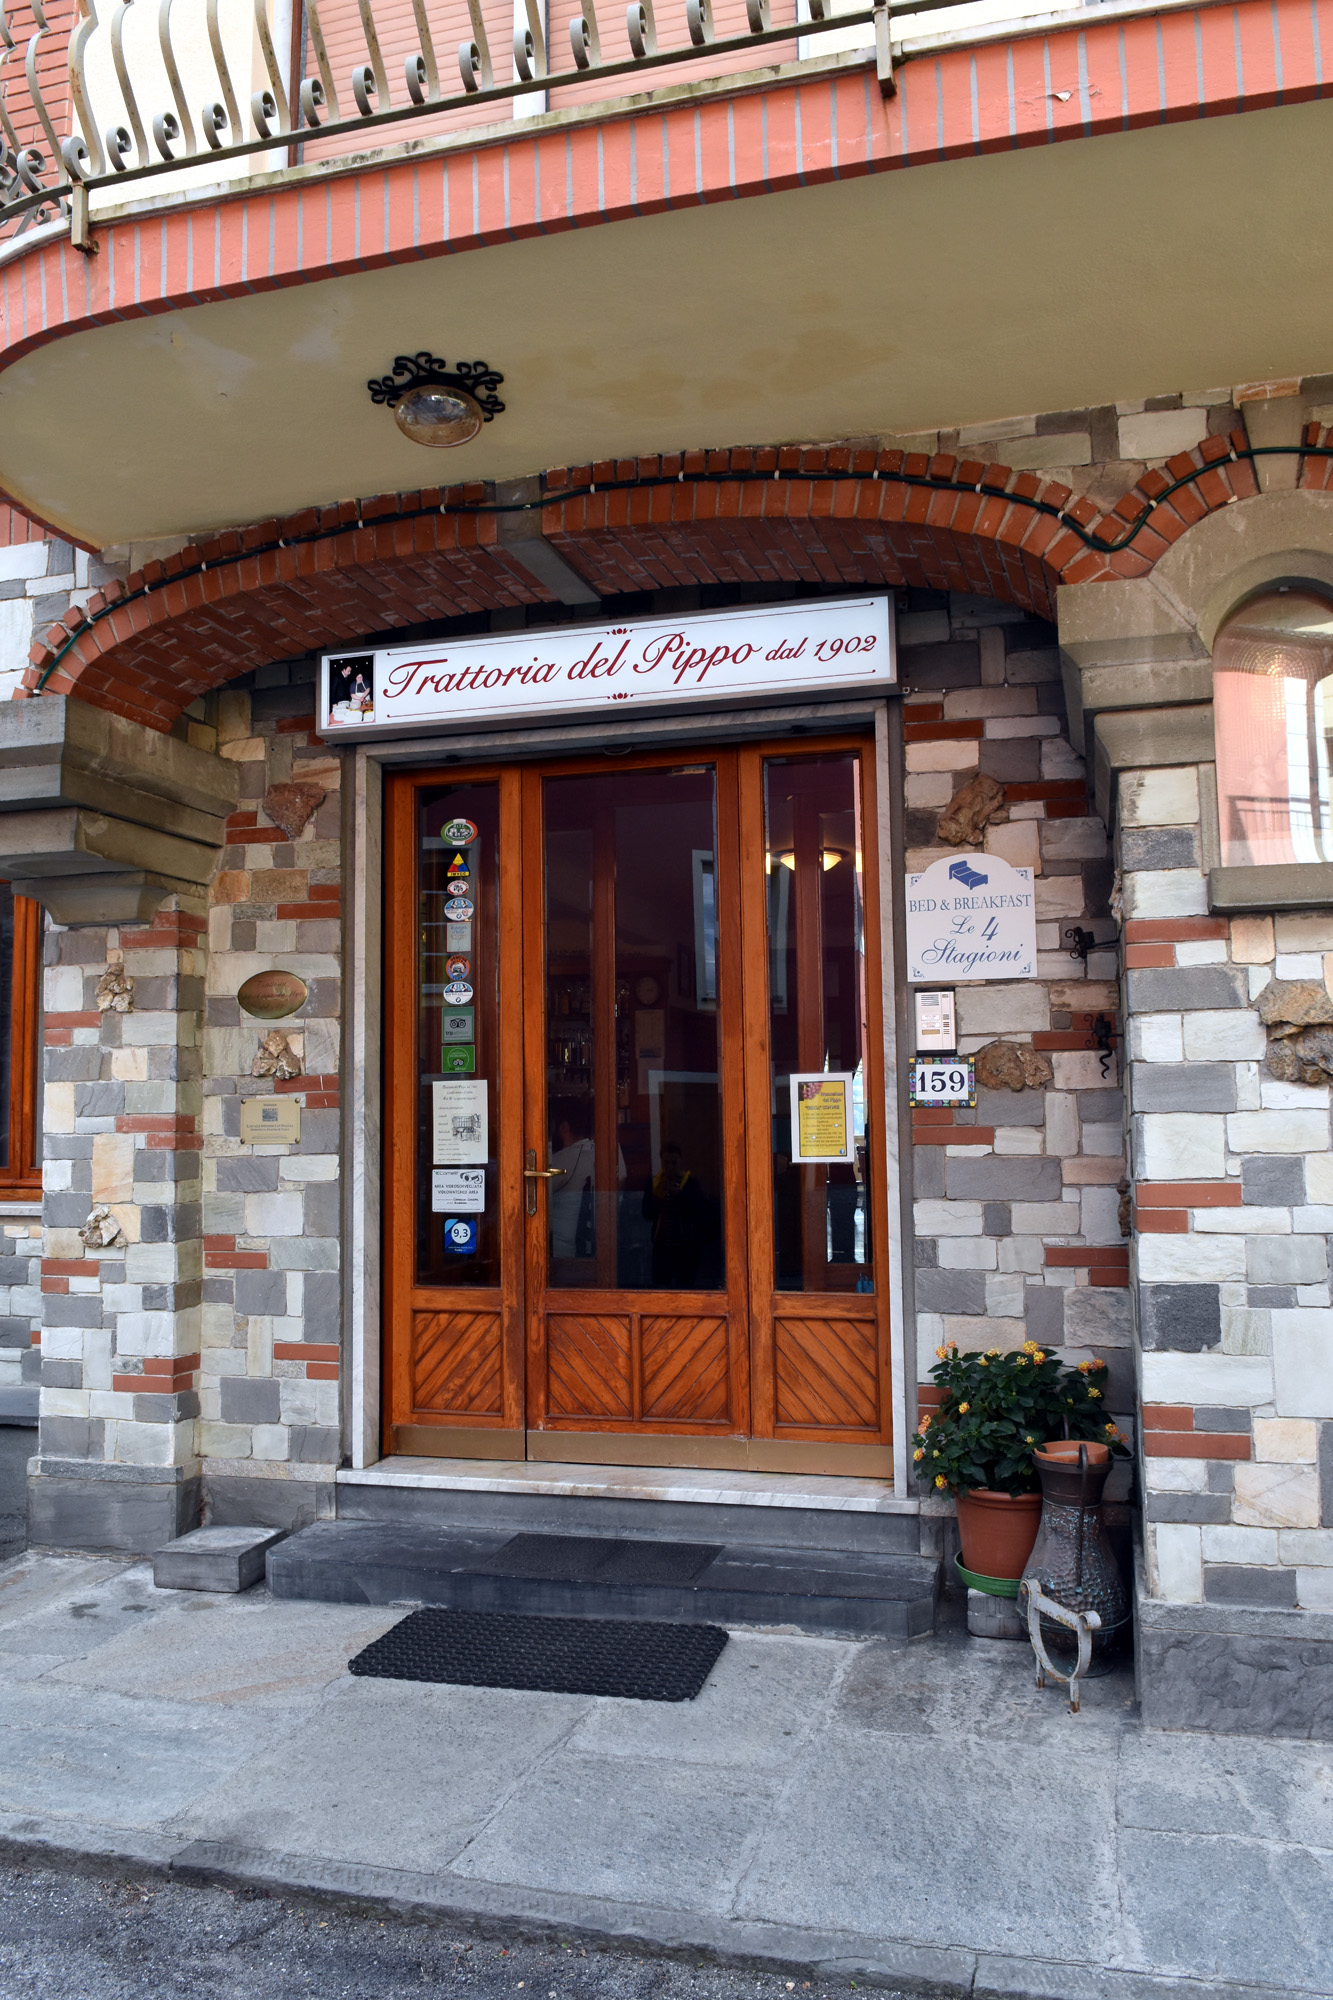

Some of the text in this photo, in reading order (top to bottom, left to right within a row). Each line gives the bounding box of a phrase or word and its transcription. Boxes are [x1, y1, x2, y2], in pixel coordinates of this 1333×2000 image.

[383, 631, 877, 699] Trattoria del Pippo dal 1902
[909, 893, 1032, 913] BED & BREAKFAST
[950, 914, 1000, 941] Le 4
[921, 937, 1024, 974] Stagioni
[917, 1070, 966, 1093] 159
[453, 1228, 469, 1239] 9,3
